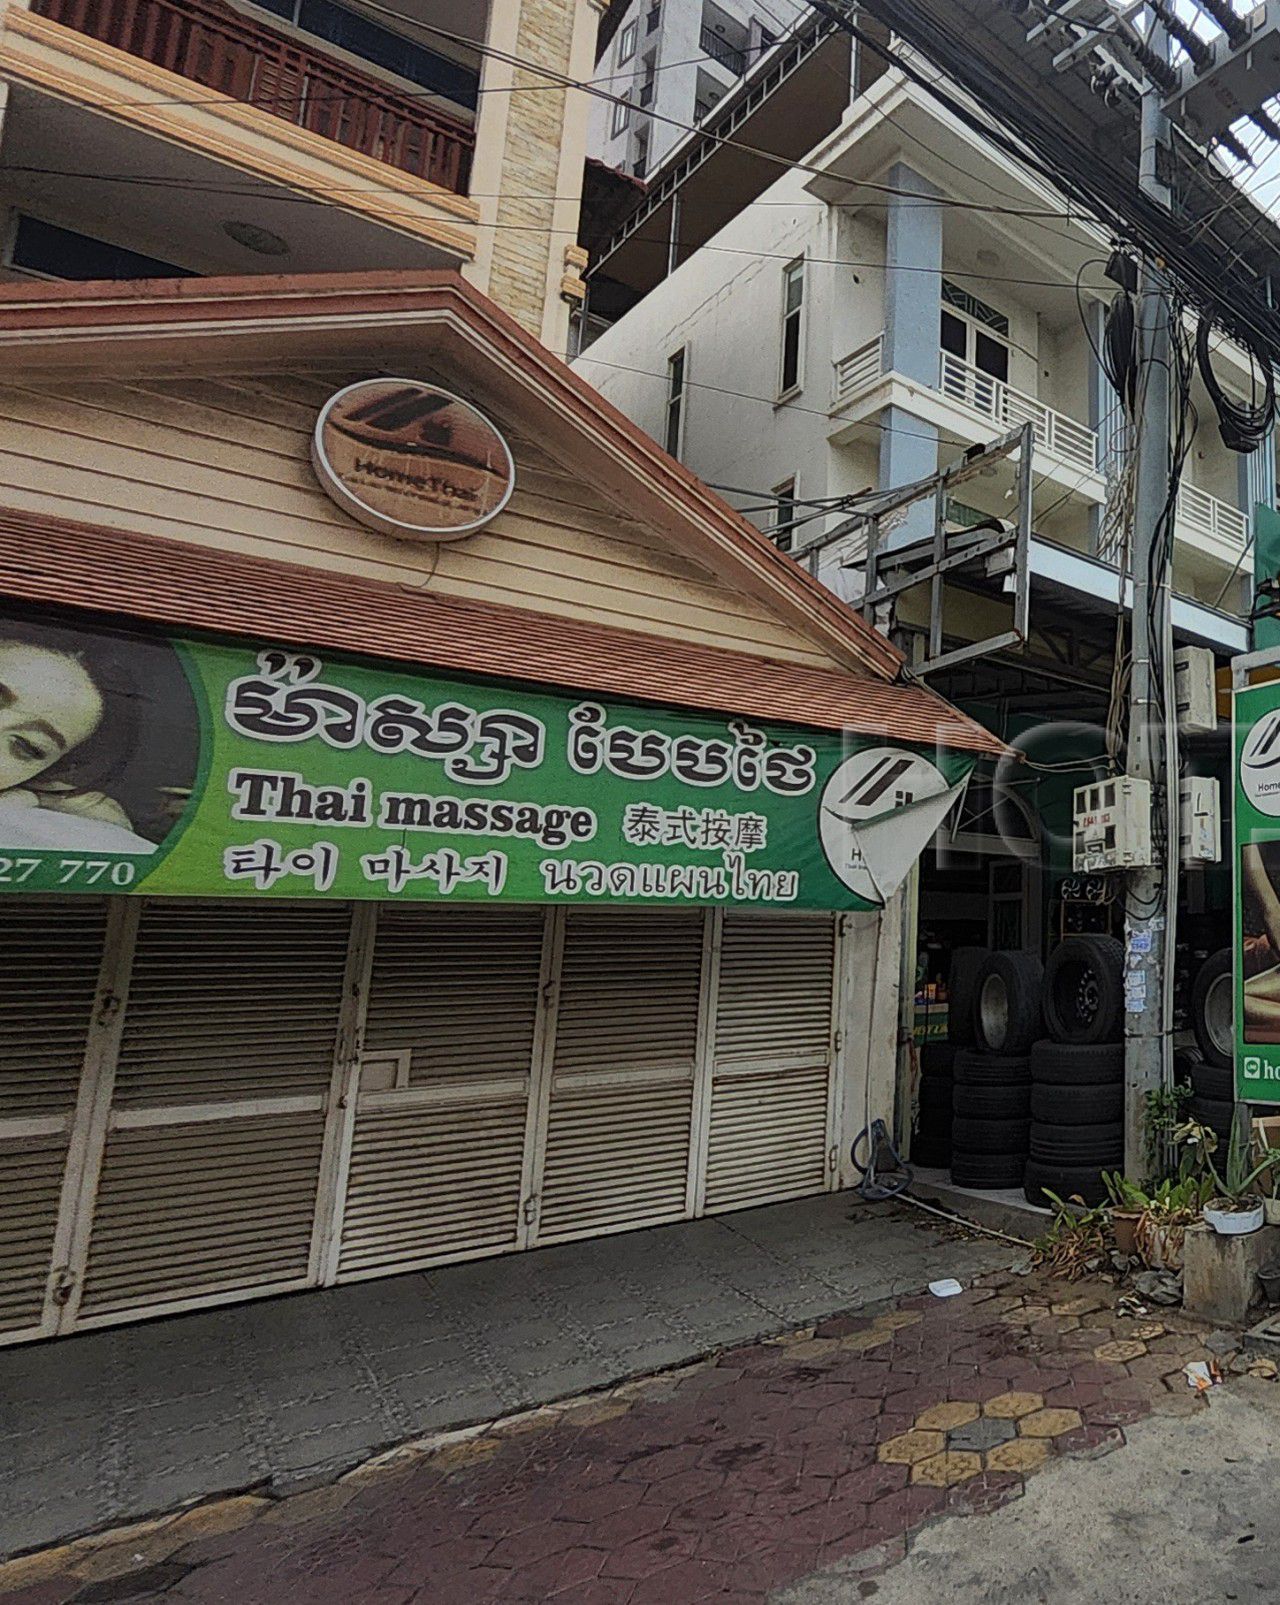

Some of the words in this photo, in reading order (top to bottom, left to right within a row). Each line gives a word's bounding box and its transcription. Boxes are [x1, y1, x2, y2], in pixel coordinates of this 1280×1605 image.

[571, 704, 815, 794] បែបថៃ
[233, 772, 369, 824] Thai
[383, 795, 594, 845] massage
[626, 804, 769, 851] 泰式按摩
[58, 859, 135, 886] 770
[230, 844, 334, 886] 타이
[366, 849, 503, 892] 마사지
[544, 852, 799, 899] นวดแผนไทย
